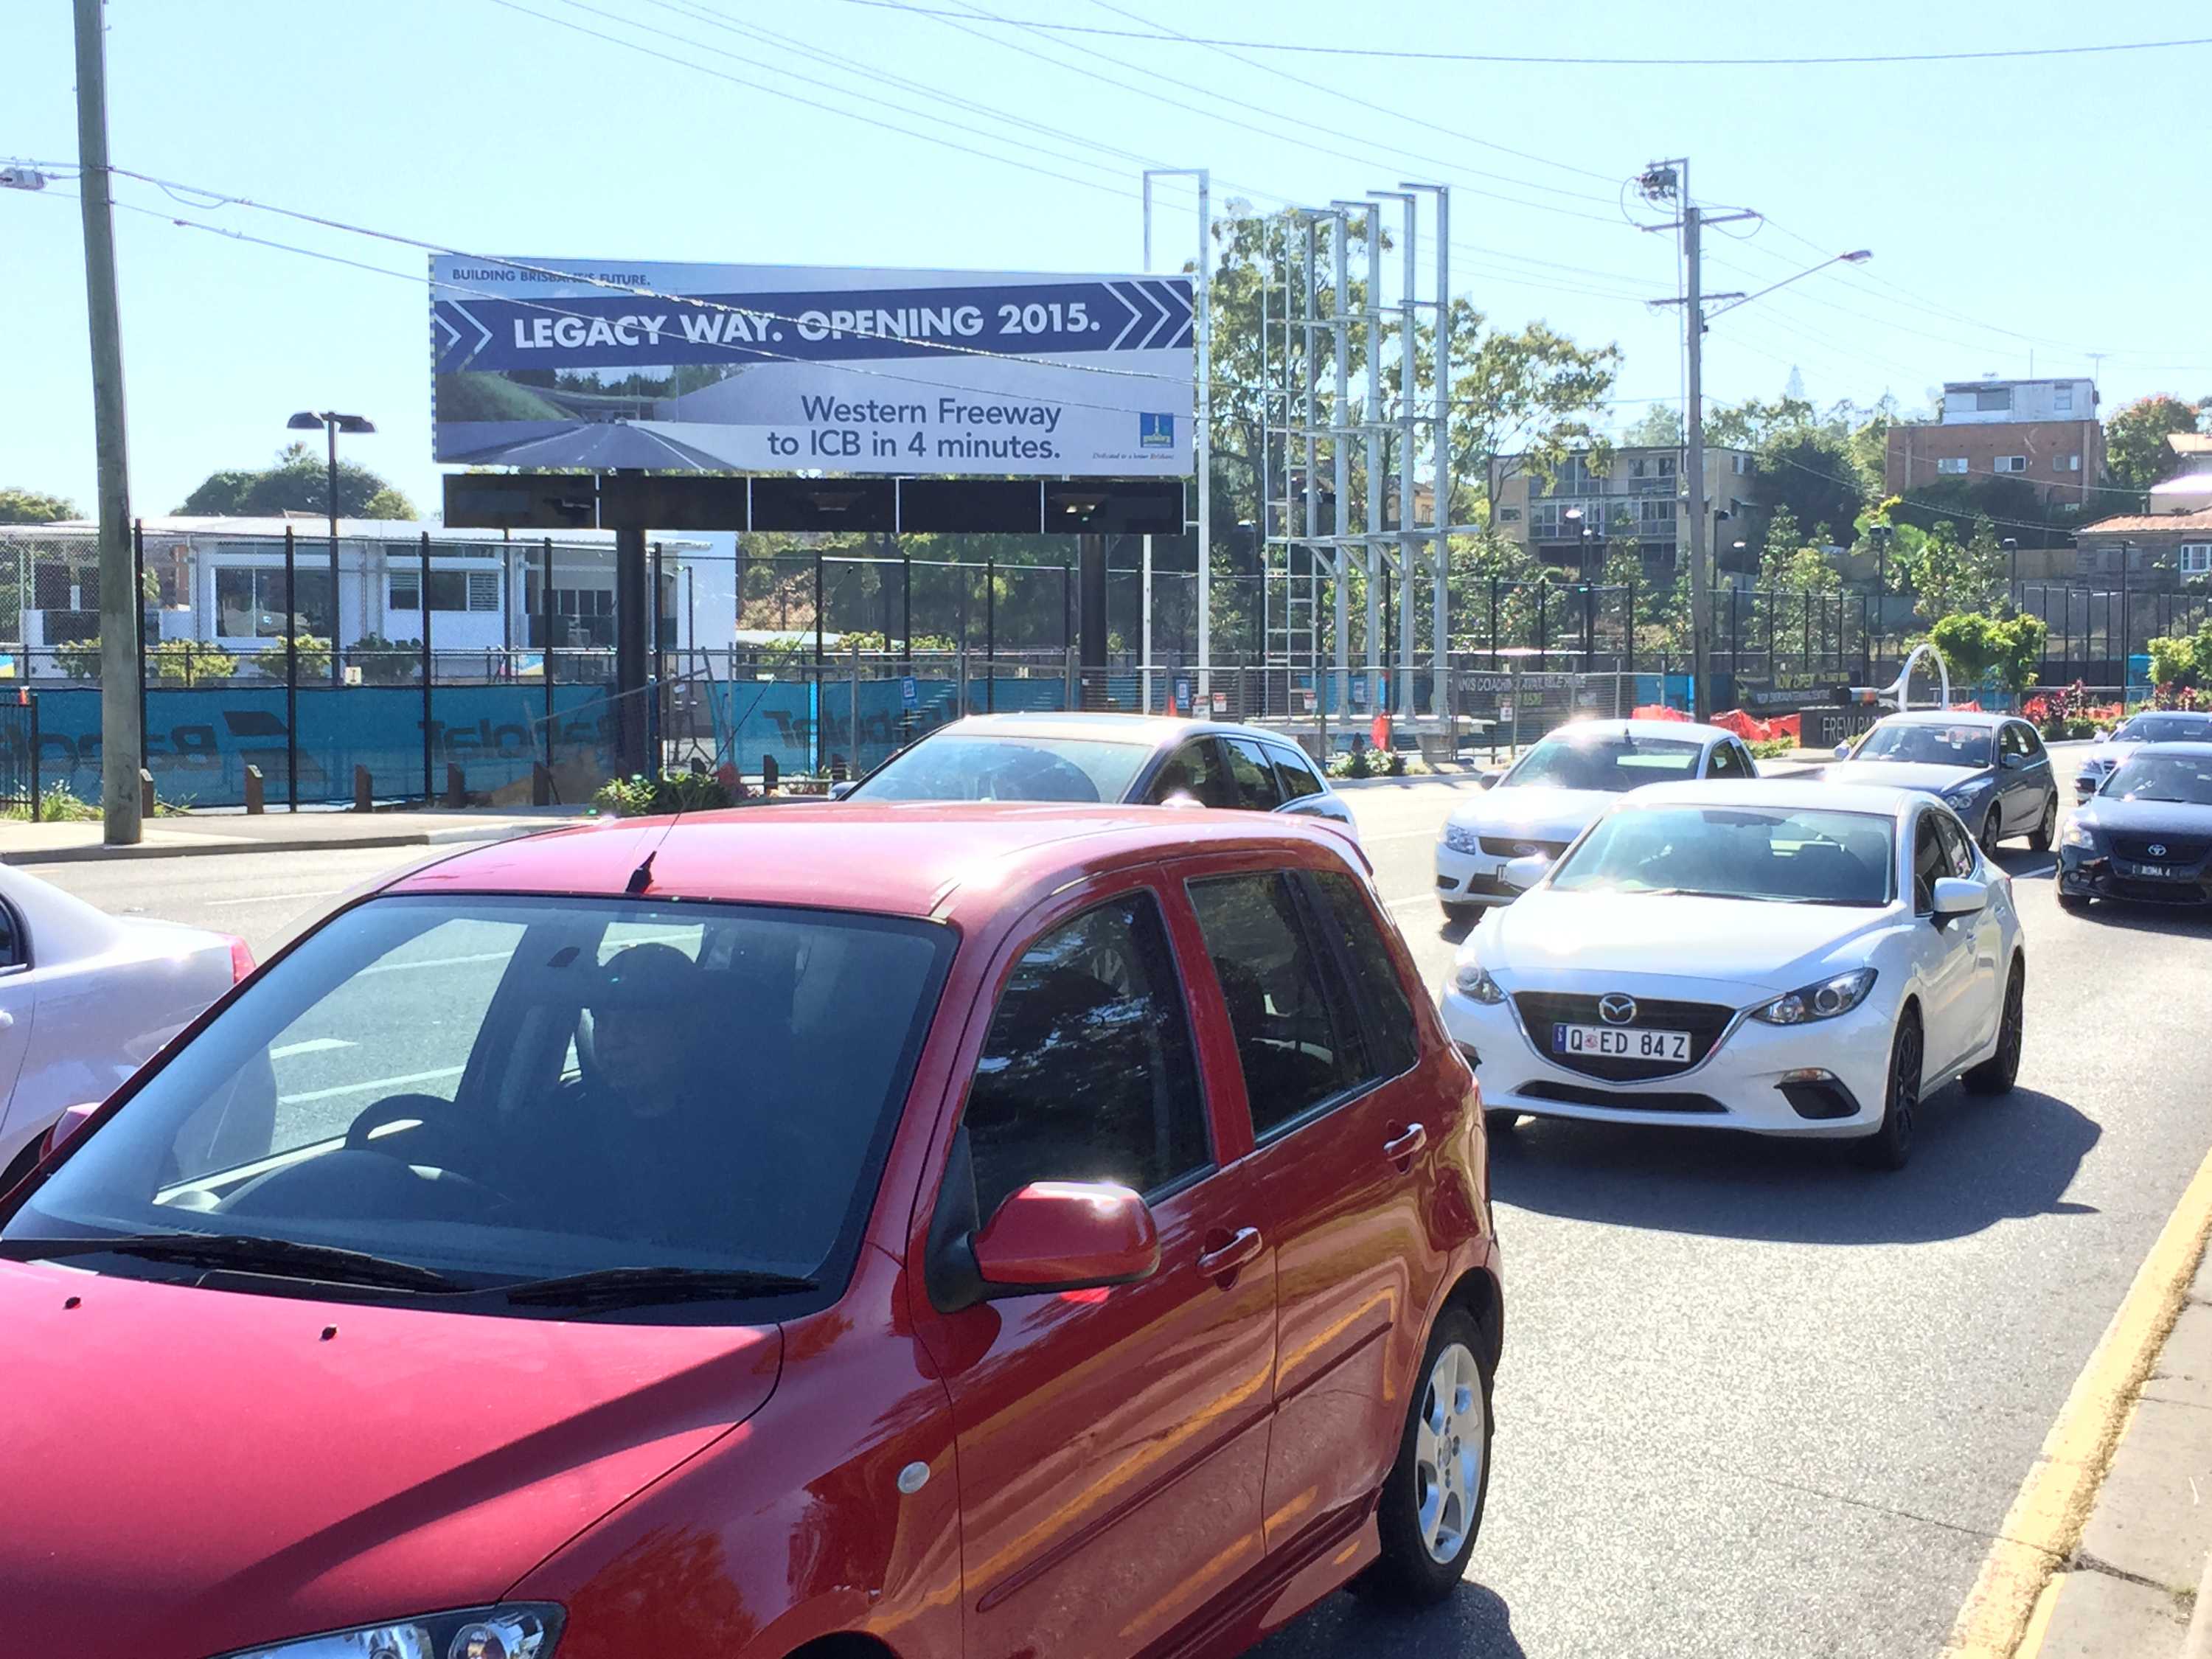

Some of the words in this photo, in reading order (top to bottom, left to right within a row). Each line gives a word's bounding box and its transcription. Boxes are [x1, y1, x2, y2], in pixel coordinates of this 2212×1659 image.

[453, 268, 515, 282] BUILDING
[599, 273, 651, 286] FUTURE.
[514, 314, 667, 349] LEGACY
[679, 313, 783, 344] WAY.
[797, 305, 984, 341] OPENING
[998, 302, 1101, 335] 2015.
[801, 394, 927, 423] Western
[939, 397, 1062, 434] Freeway
[767, 431, 799, 456] to
[811, 429, 861, 456] ICB
[872, 431, 897, 457] in
[907, 431, 927, 457] 4
[937, 432, 1061, 459] minutes.
[1823, 716, 1857, 742] FREW
[1600, 1031, 1628, 1054] ED
